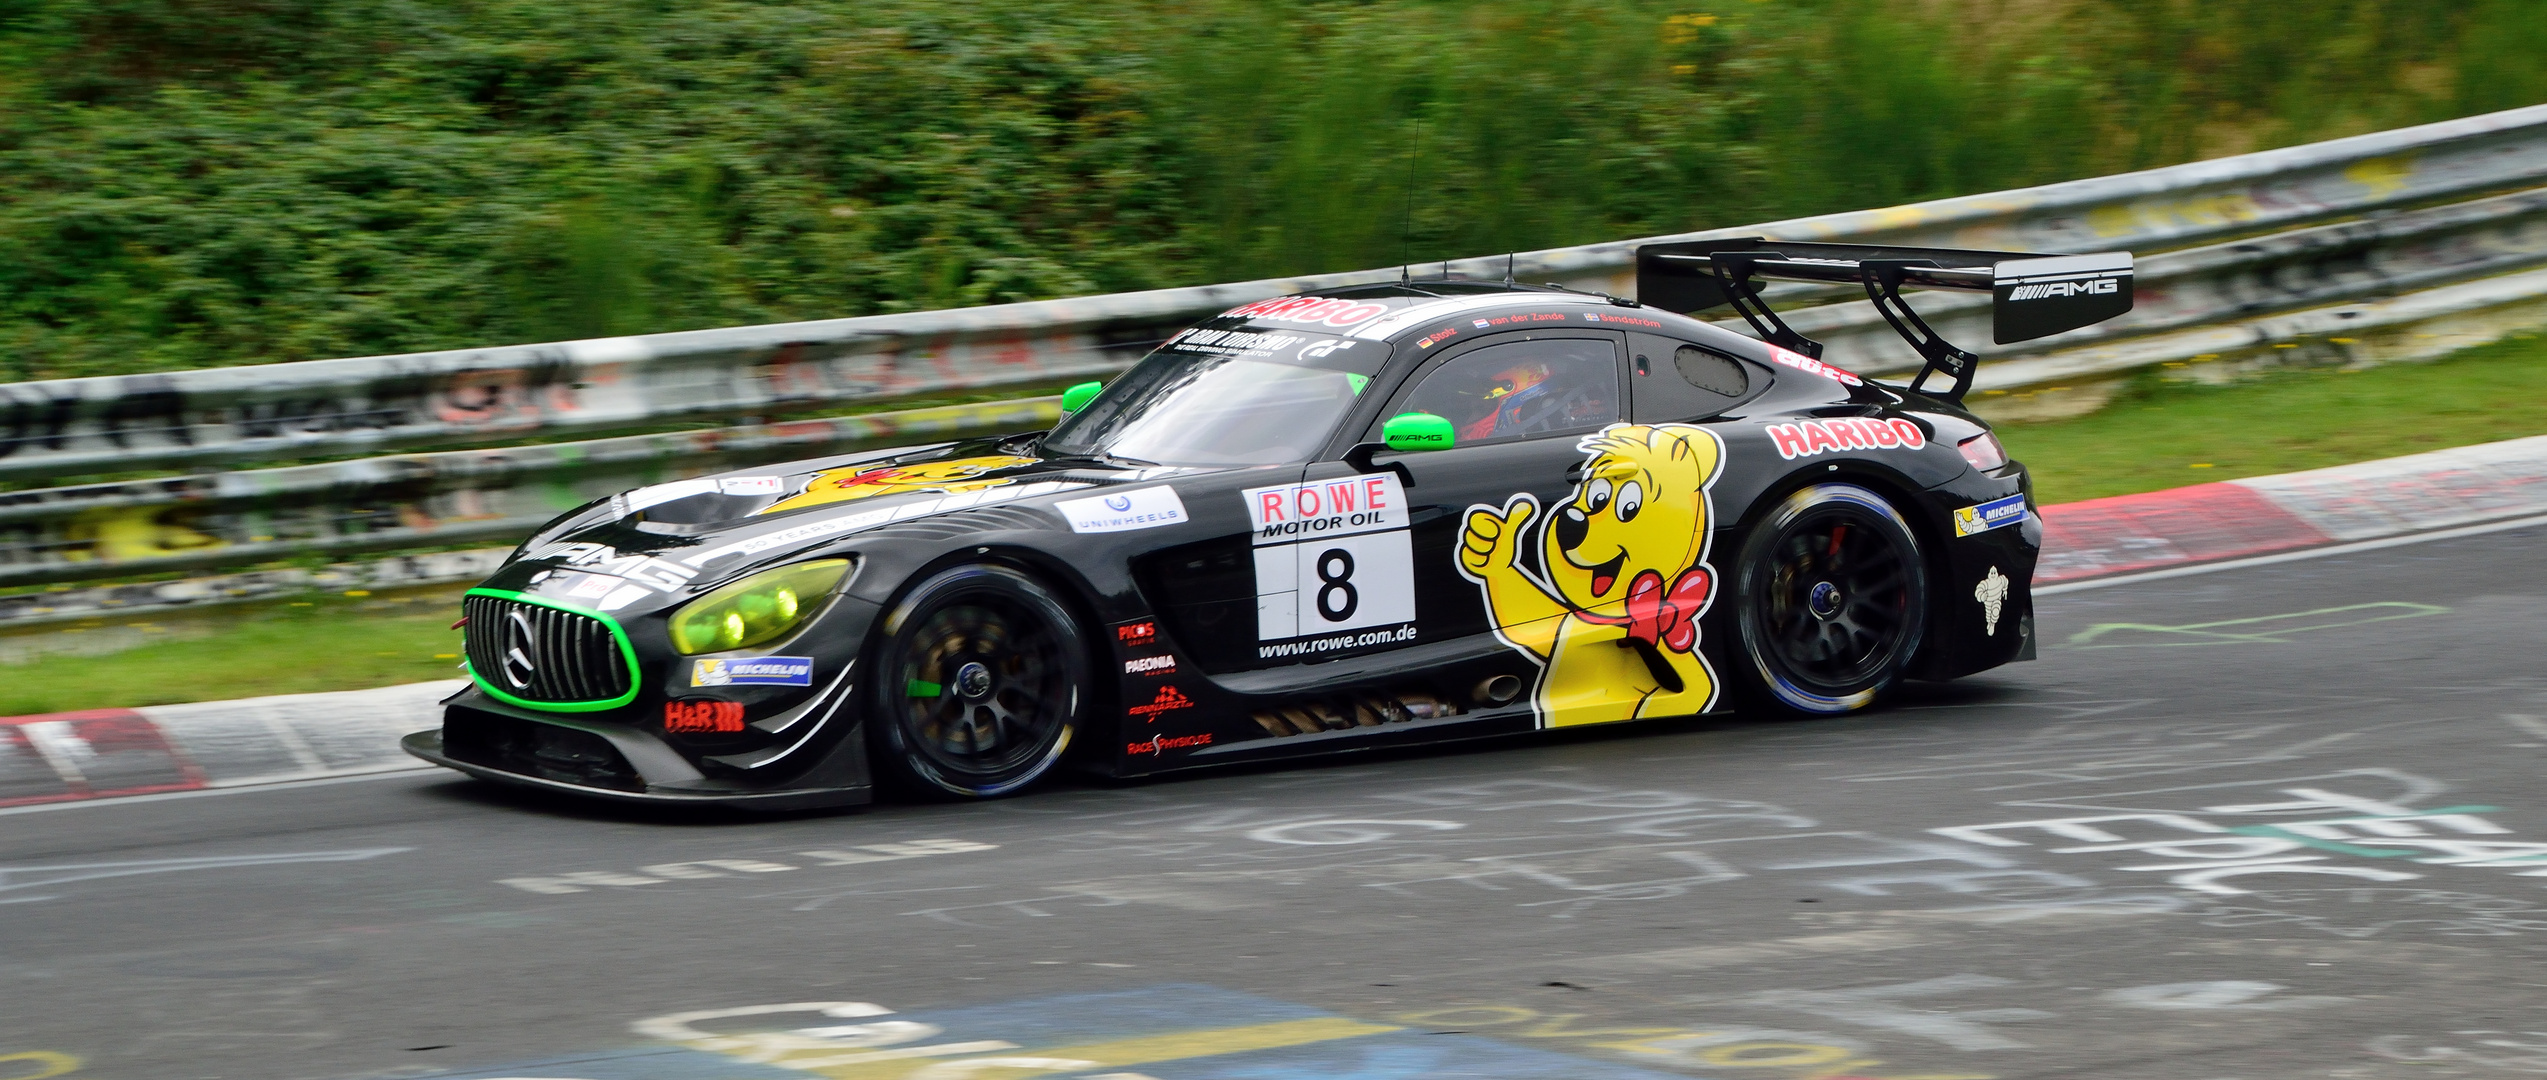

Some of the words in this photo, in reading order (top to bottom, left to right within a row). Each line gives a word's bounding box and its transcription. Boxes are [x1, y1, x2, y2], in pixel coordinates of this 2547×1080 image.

[2048, 278, 2118, 298] AMG
[1489, 317, 1509, 326] van
[1511, 314, 1528, 325] der
[1530, 312, 1566, 322] Zande
[1600, 313, 1662, 329] Sandström
[1430, 326, 1457, 344] Stolz
[1408, 434, 1443, 442] AMG
[1765, 417, 1926, 460] HARIBO
[1259, 478, 1387, 524] ROWE
[1986, 501, 2025, 520] MICHELIN
[1078, 510, 1178, 529] UNIWHEELS
[1262, 517, 1342, 538] MOTOR
[1350, 511, 1385, 526] OIL
[774, 523, 836, 541] YEARS
[545, 541, 700, 593] AMG
[1316, 547, 1359, 622] 8
[1259, 624, 1417, 659] www.rowe.com.de
[730, 663, 808, 676] MICHELIN
[1125, 654, 1176, 674] PAEONIA
[665, 701, 714, 732] H&R
